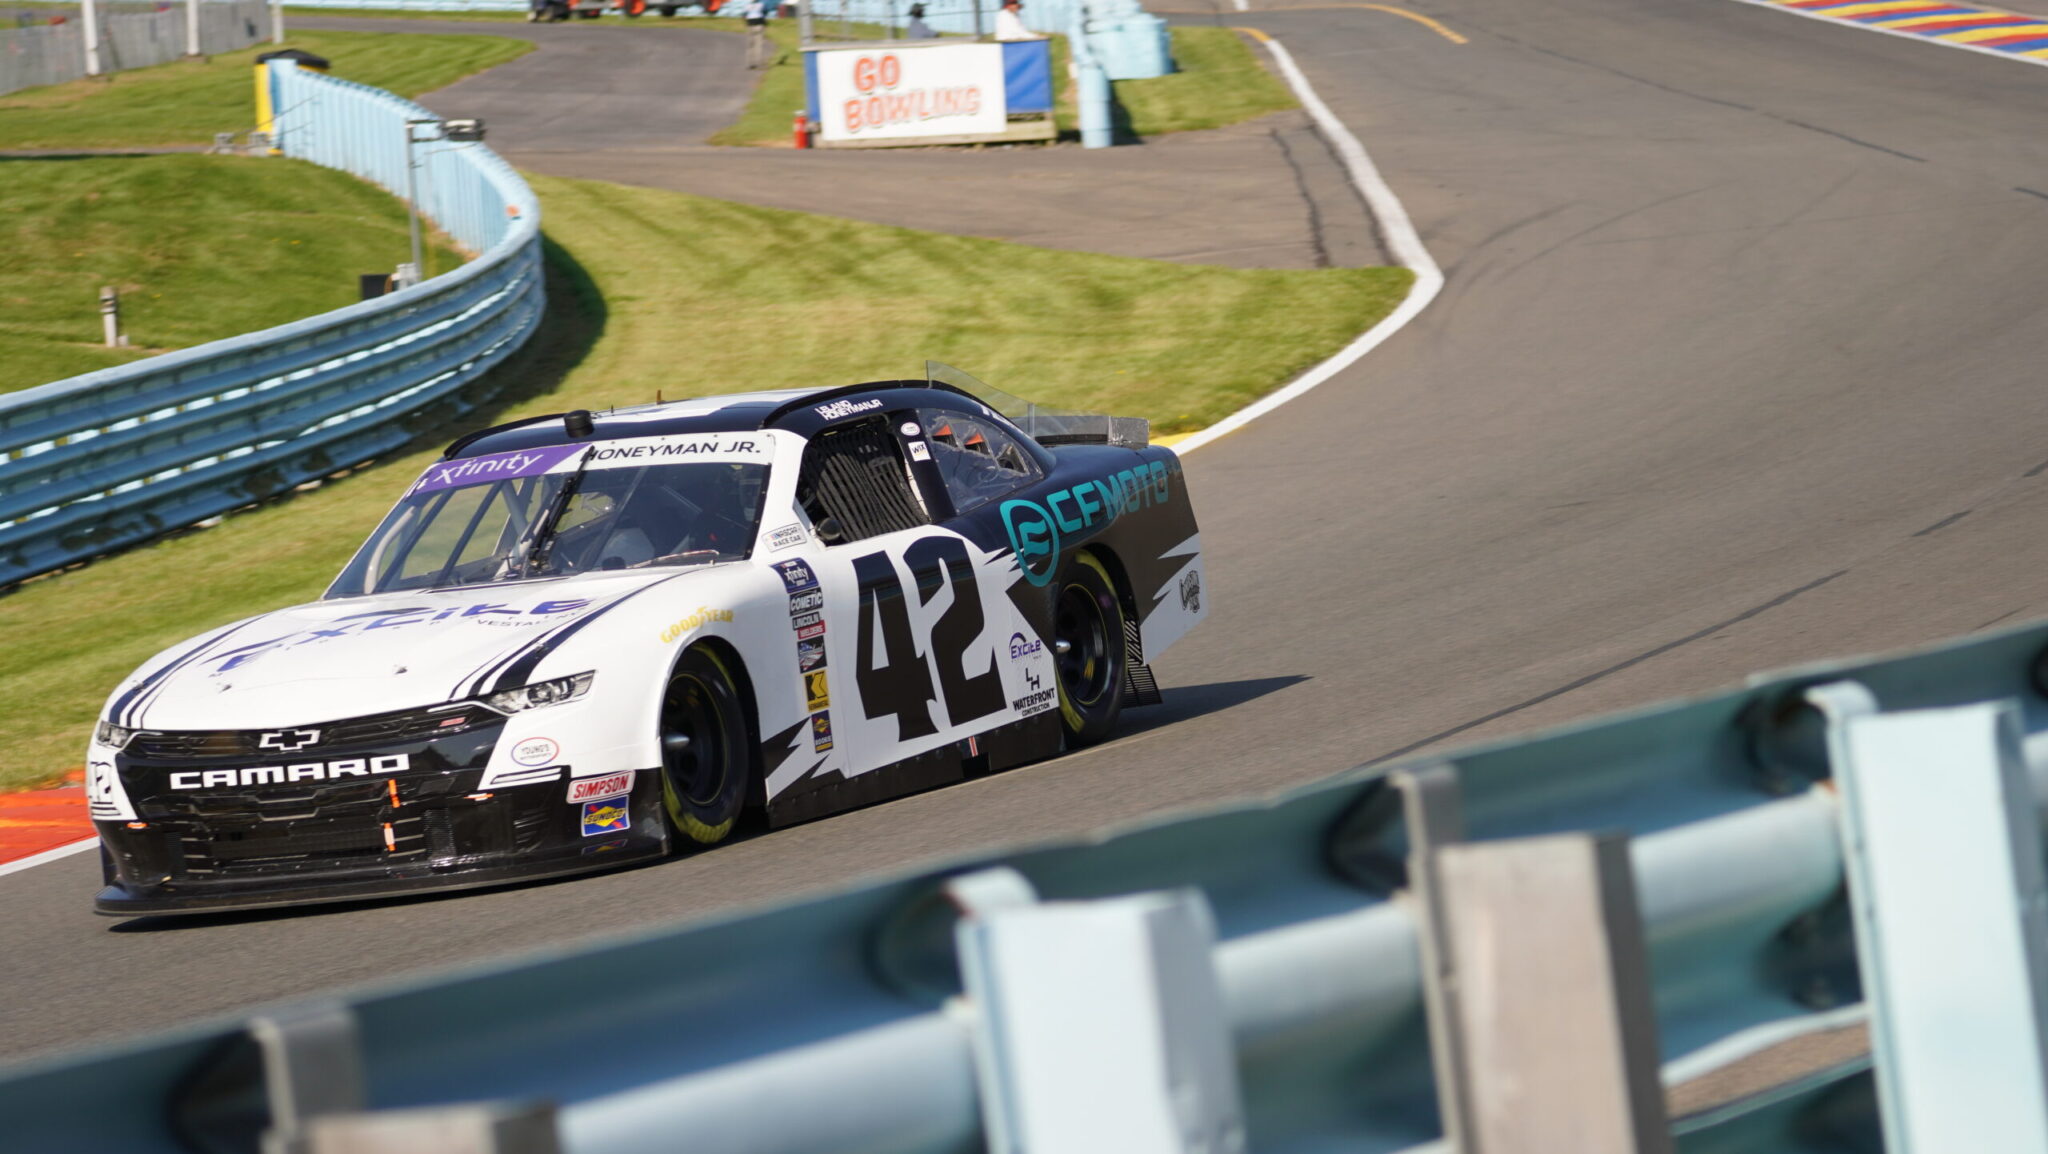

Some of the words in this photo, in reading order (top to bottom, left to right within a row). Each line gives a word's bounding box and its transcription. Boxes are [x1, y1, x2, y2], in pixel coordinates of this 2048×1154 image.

[853, 55, 901, 93] GO
[843, 87, 981, 133] BOWLING
[724, 441, 761, 453] JR.
[911, 444, 926, 454] WIX
[1046, 460, 1169, 535] CFMOTO
[790, 592, 823, 612] COMETIC
[660, 606, 734, 645] GOODYEAR
[850, 535, 1008, 743] 42
[1012, 687, 1055, 712] WATERFRONT
[1021, 702, 1051, 717] CONSTRUCTION
[169, 753, 410, 790] CAMARO
[573, 774, 629, 799] SIMPSON
[586, 808, 625, 823] SUNOCO
